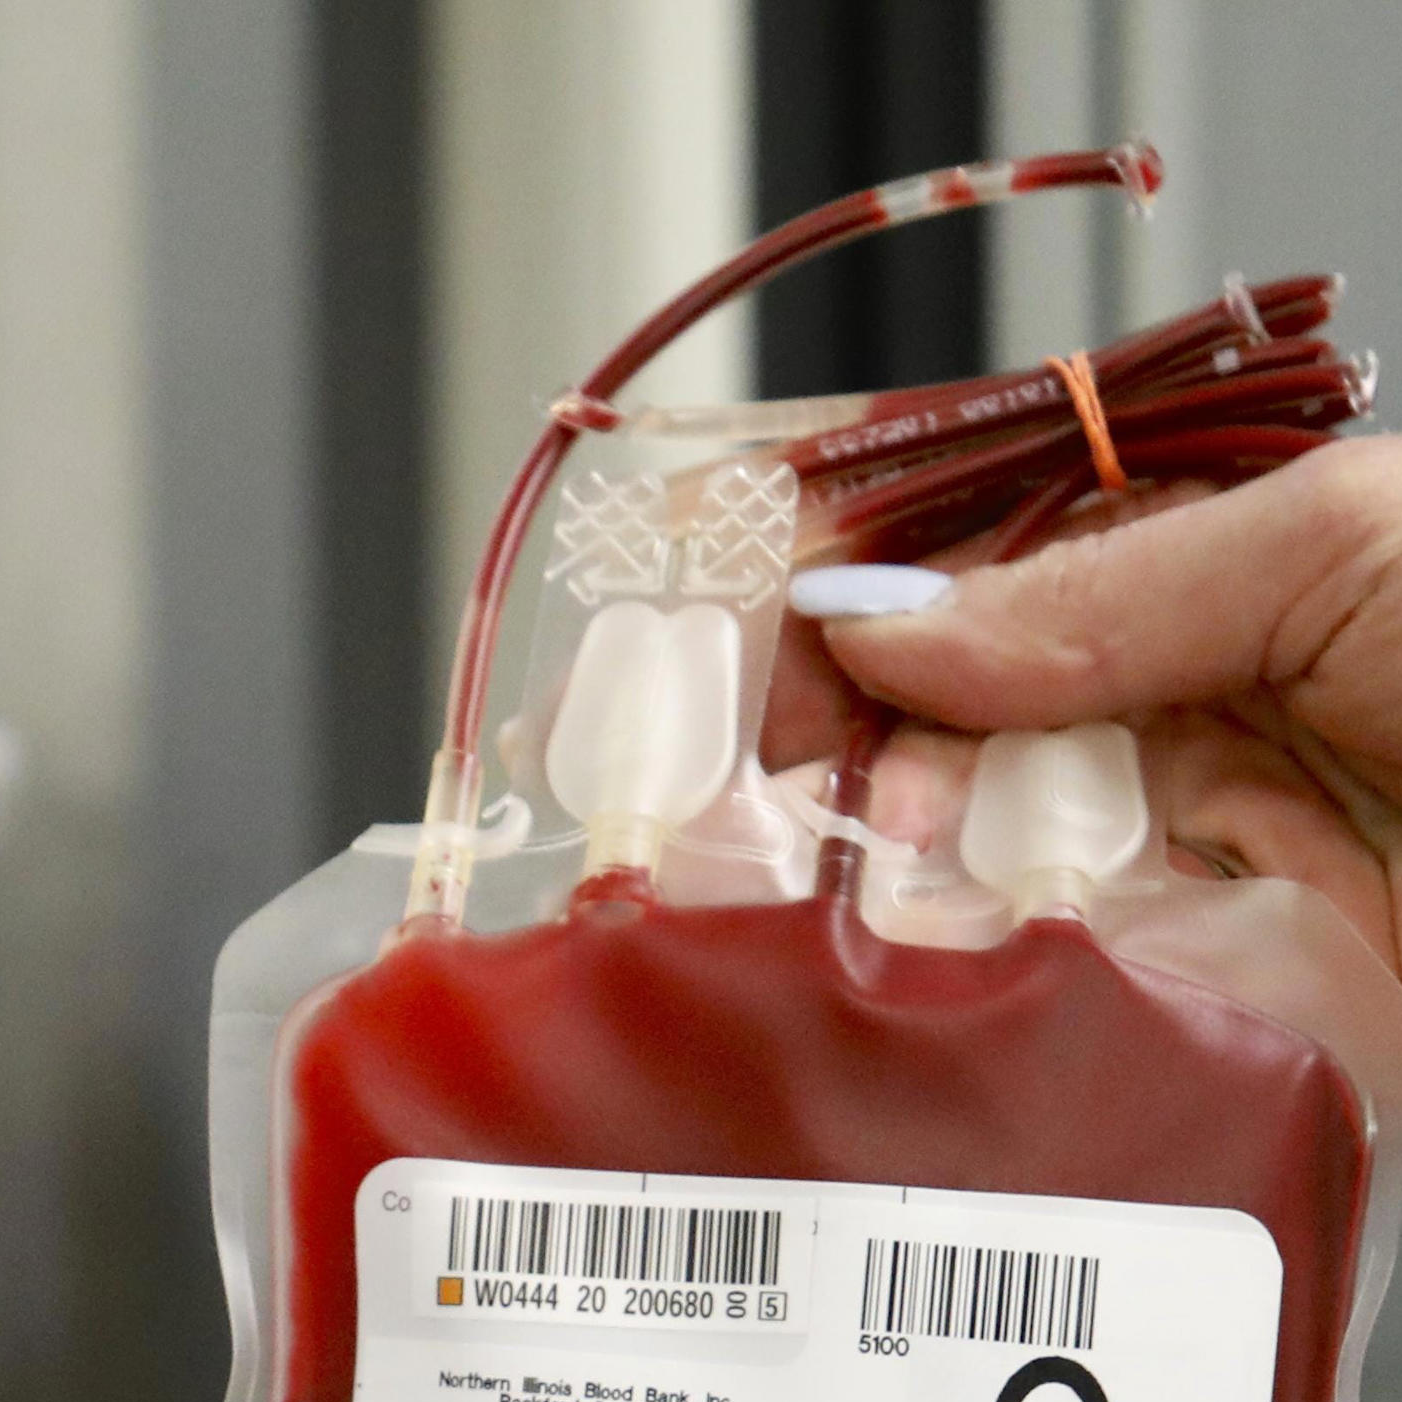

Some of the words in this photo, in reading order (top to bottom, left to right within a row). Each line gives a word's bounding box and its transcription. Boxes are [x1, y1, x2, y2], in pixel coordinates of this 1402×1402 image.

[474, 1278, 559, 1310] W0444
[576, 1285, 606, 1314] 20
[623, 1288, 714, 1318] 200680
[858, 1334, 910, 1357] 5100
[438, 1371, 511, 1392] Northern
[584, 1382, 634, 1401] Blood
